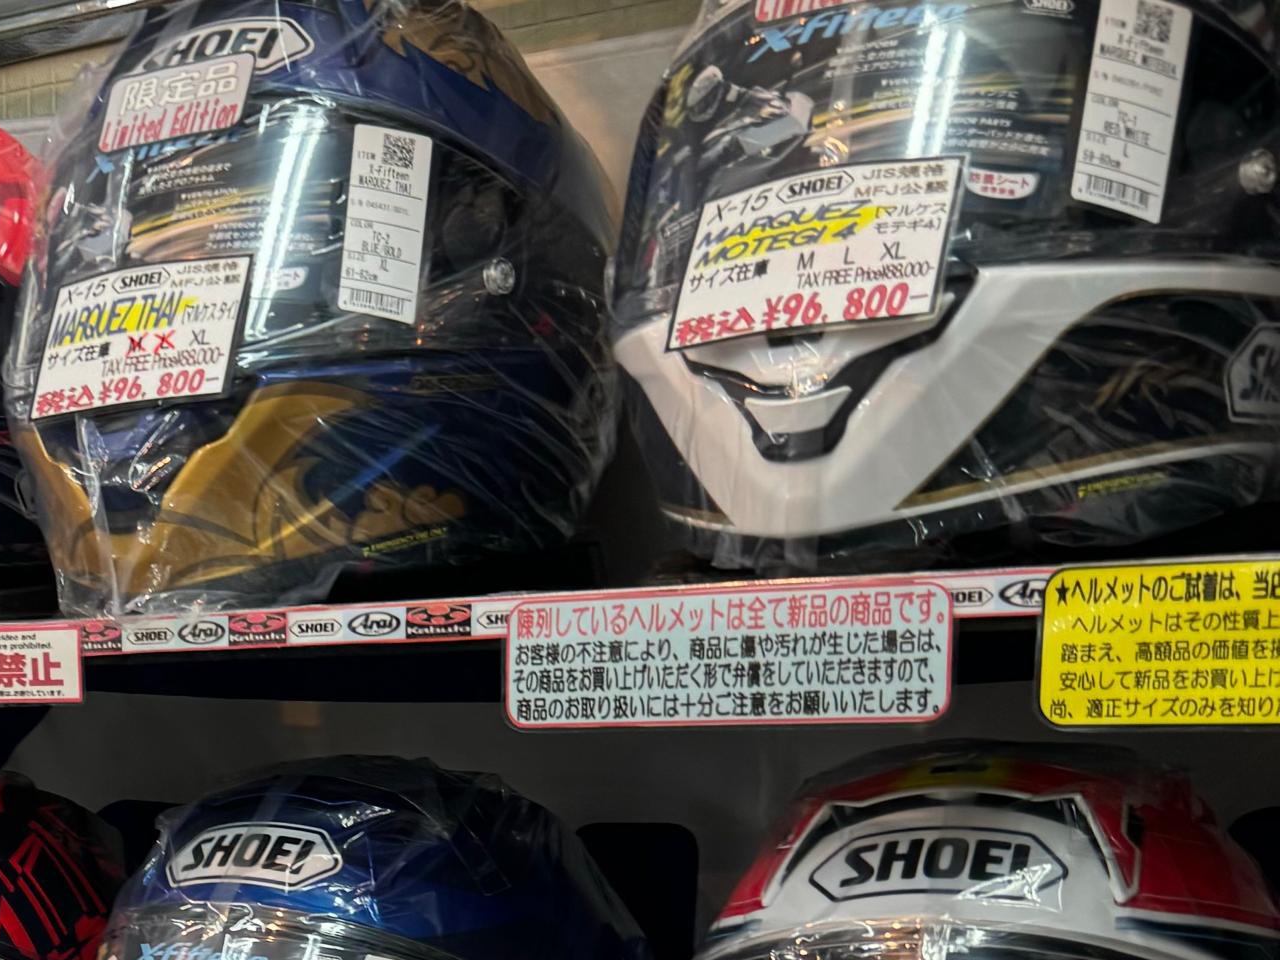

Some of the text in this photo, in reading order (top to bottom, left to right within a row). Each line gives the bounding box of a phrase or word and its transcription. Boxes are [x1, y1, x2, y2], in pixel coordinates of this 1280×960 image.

[120, 62, 239, 116] 限定品
[100, 98, 239, 151] Limited Edition
[707, 175, 843, 224] X-15 SHOEI
[696, 199, 873, 250] MARQUEZ
[694, 223, 829, 270] MOTEGI
[797, 251, 816, 271] M
[843, 246, 856, 265] L
[880, 241, 907, 262] XL
[61, 271, 163, 307] X-15 SHOEI
[135, 290, 184, 331] THAI
[676, 306, 757, 346] 税込
[189, 329, 211, 346] XL
[36, 385, 95, 415] 税込
[298, 622, 336, 634] SHOEI
[358, 613, 394, 633] Arai
[517, 592, 945, 638] 陳列しているヘルメットは全て新品の商品です。
[21, 632, 37, 641] and
[134, 630, 167, 643] SHOEI
[515, 629, 942, 666] お客様の不注意により、商品に傷や汚れが生じた場合は、
[512, 657, 937, 692] その商品をお買い上げいただく形で弁償をしていただきますので、
[516, 689, 941, 721] 商品のお取り扱いには十分ご注意をお願いいたします。
[182, 833, 316, 875] SHOEI
[839, 837, 1032, 888] SHOEI
